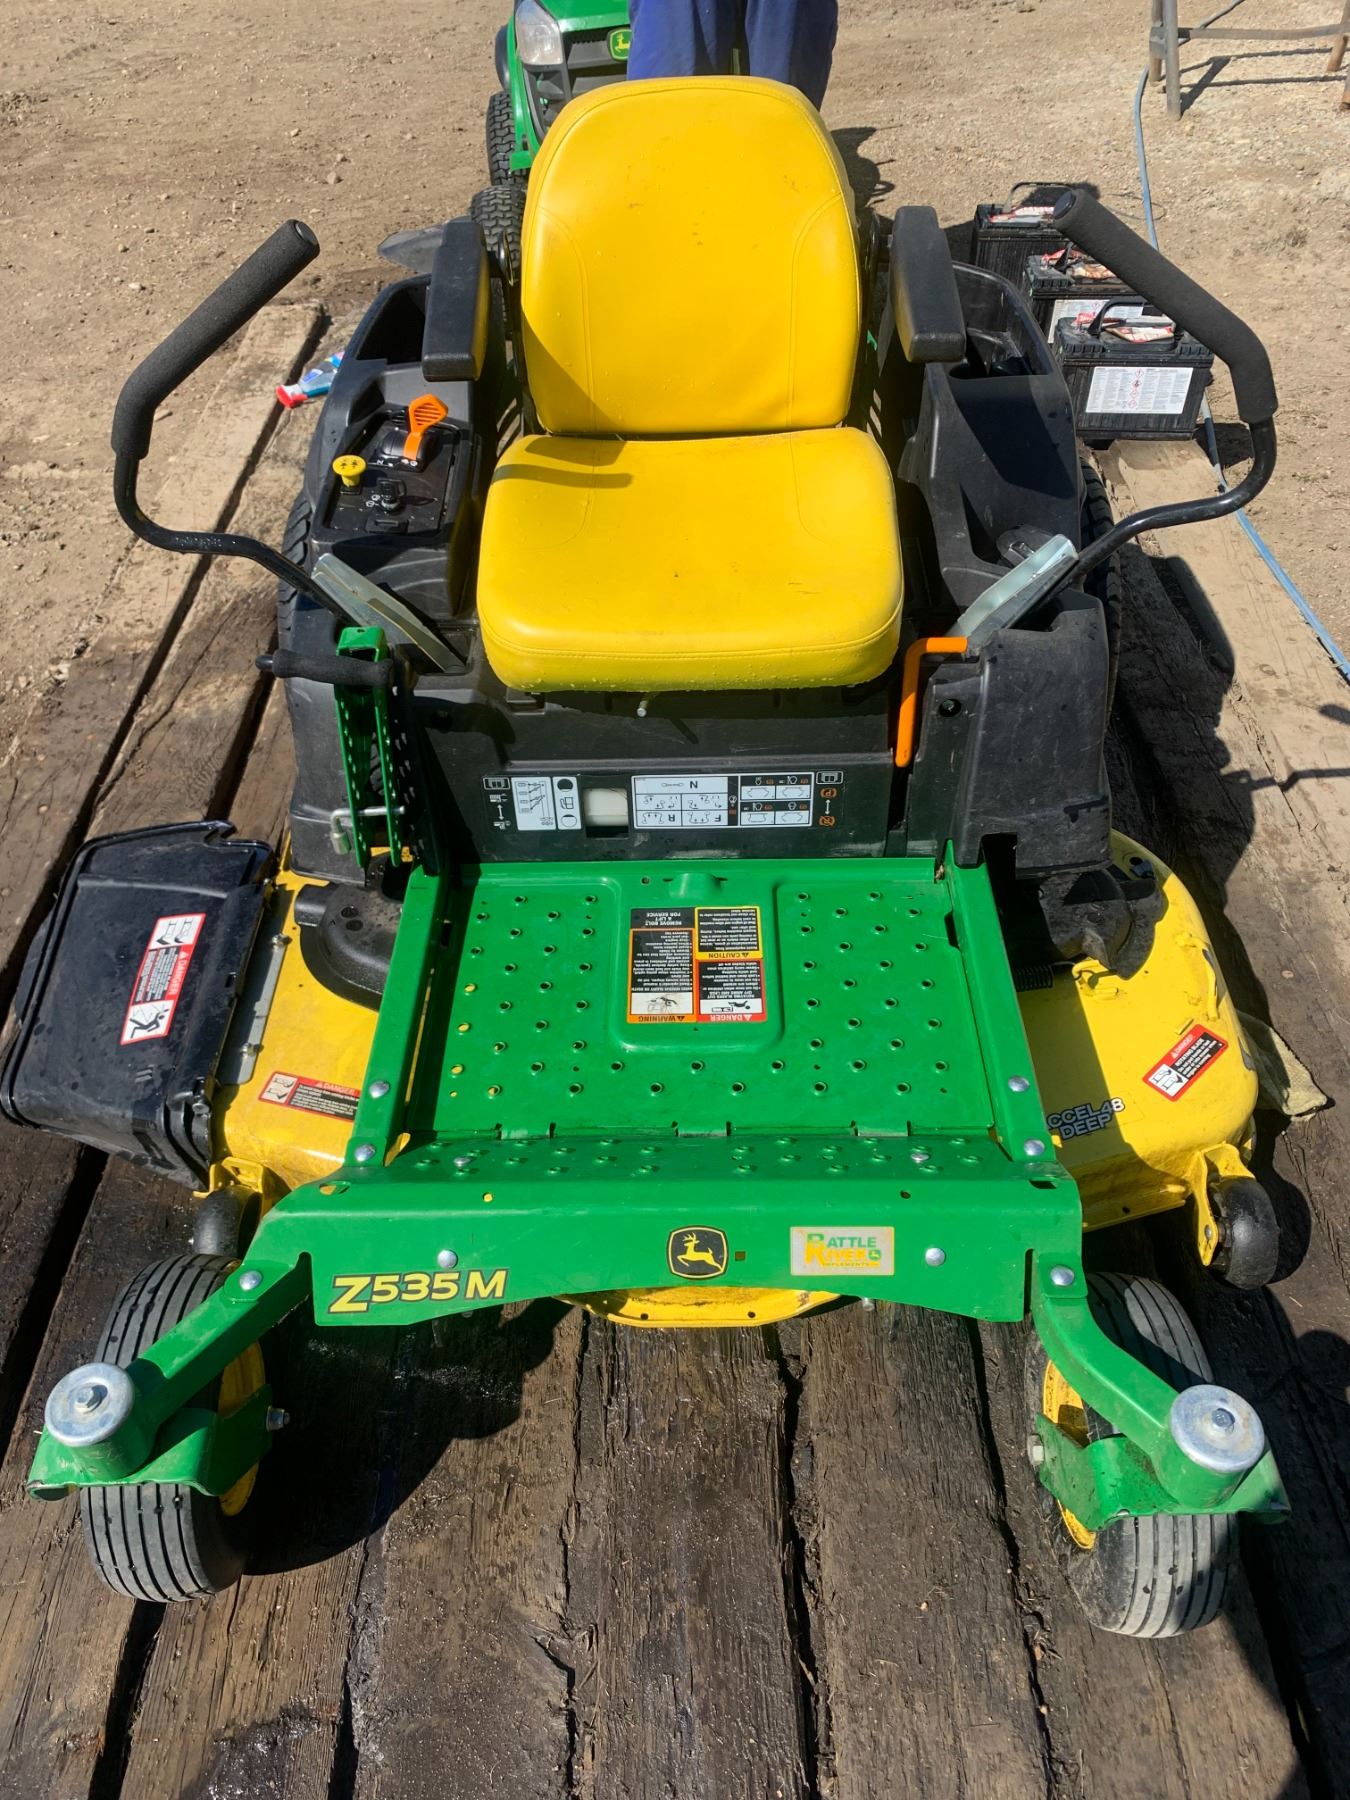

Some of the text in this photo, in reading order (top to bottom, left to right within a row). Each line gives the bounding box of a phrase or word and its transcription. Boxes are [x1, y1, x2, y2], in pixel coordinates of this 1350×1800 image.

[689, 780, 698, 789] N
[668, 814, 676, 822] R
[714, 814, 722, 822] F
[169, 959, 186, 995] DANGER
[638, 1014, 676, 1022] WARNING
[709, 1014, 741, 1022] DANGER
[1059, 1112, 1113, 1140] DEEP
[807, 1233, 877, 1248] RATTLE
